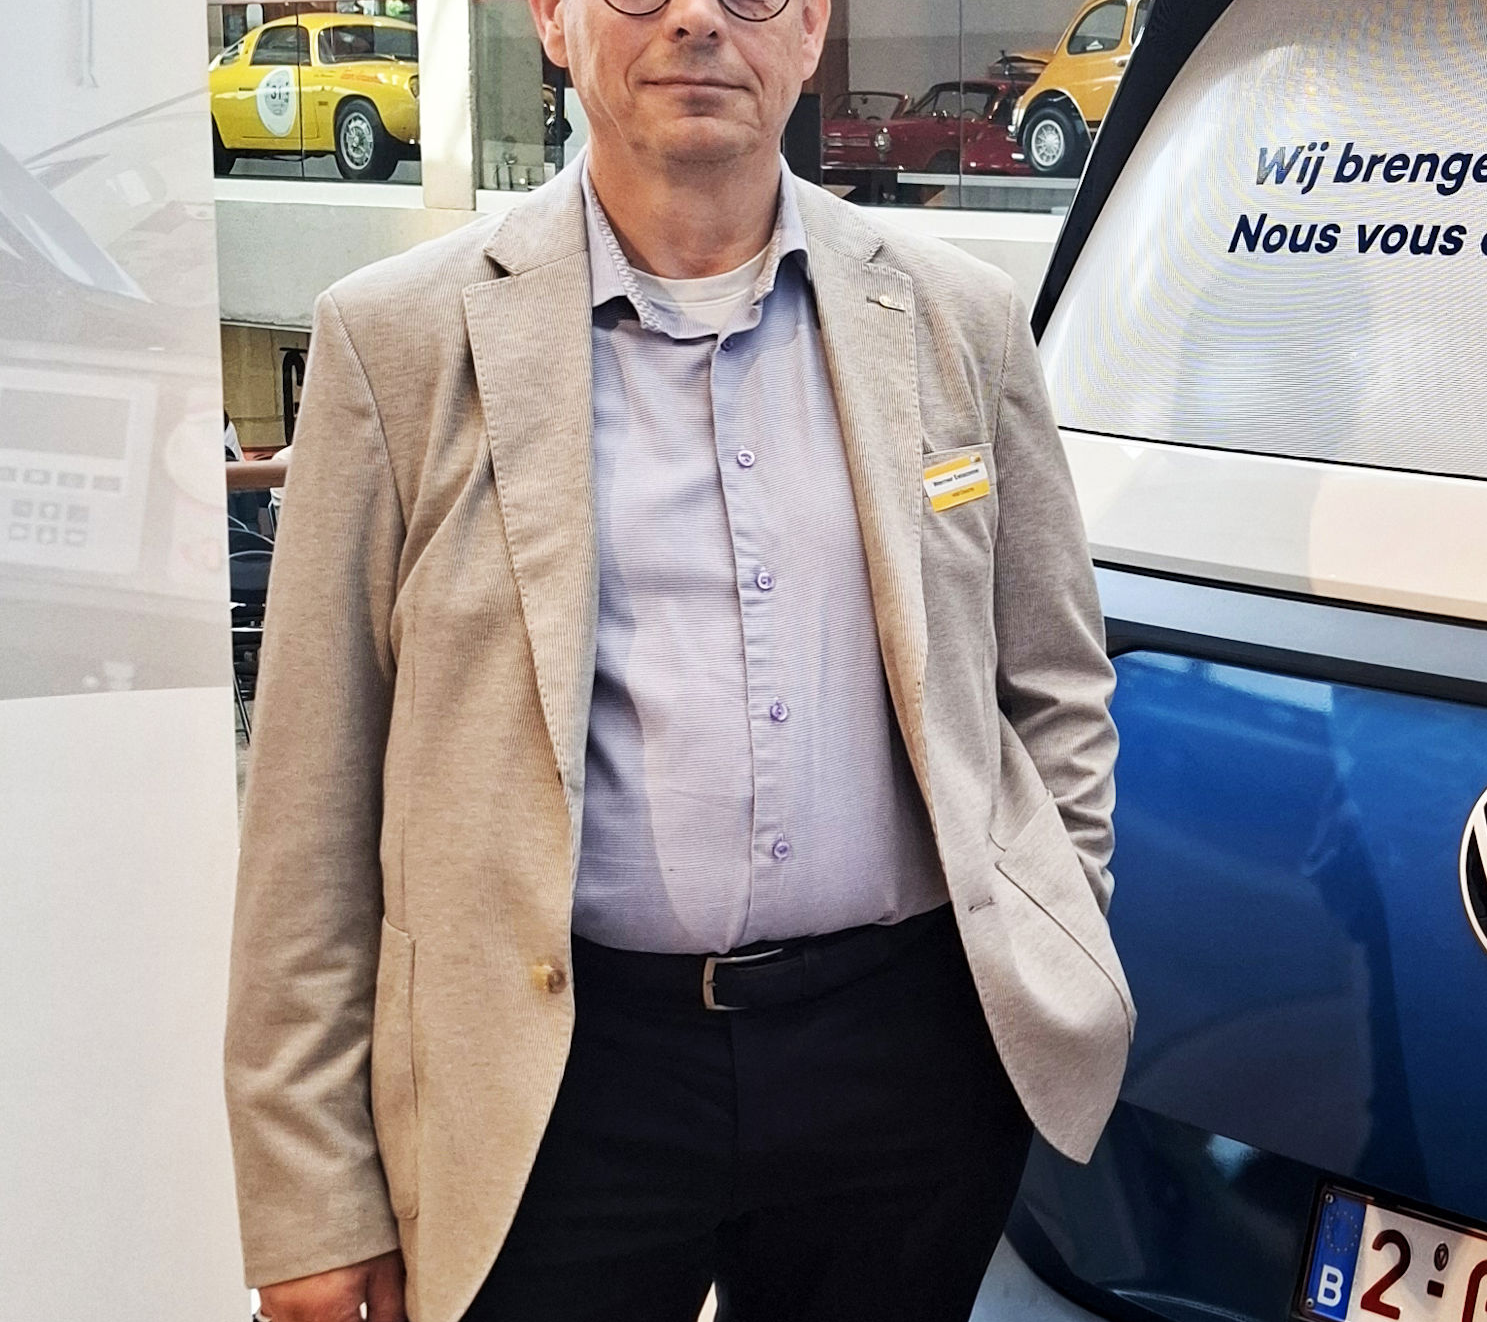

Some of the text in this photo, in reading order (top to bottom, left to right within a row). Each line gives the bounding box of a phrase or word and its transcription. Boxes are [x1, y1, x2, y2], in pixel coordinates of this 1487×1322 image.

[1256, 142, 1329, 195] Wij
[1228, 213, 1341, 254] Nous
[1357, 224, 1467, 256] vous
[1316, 1264, 1344, 1308] B
